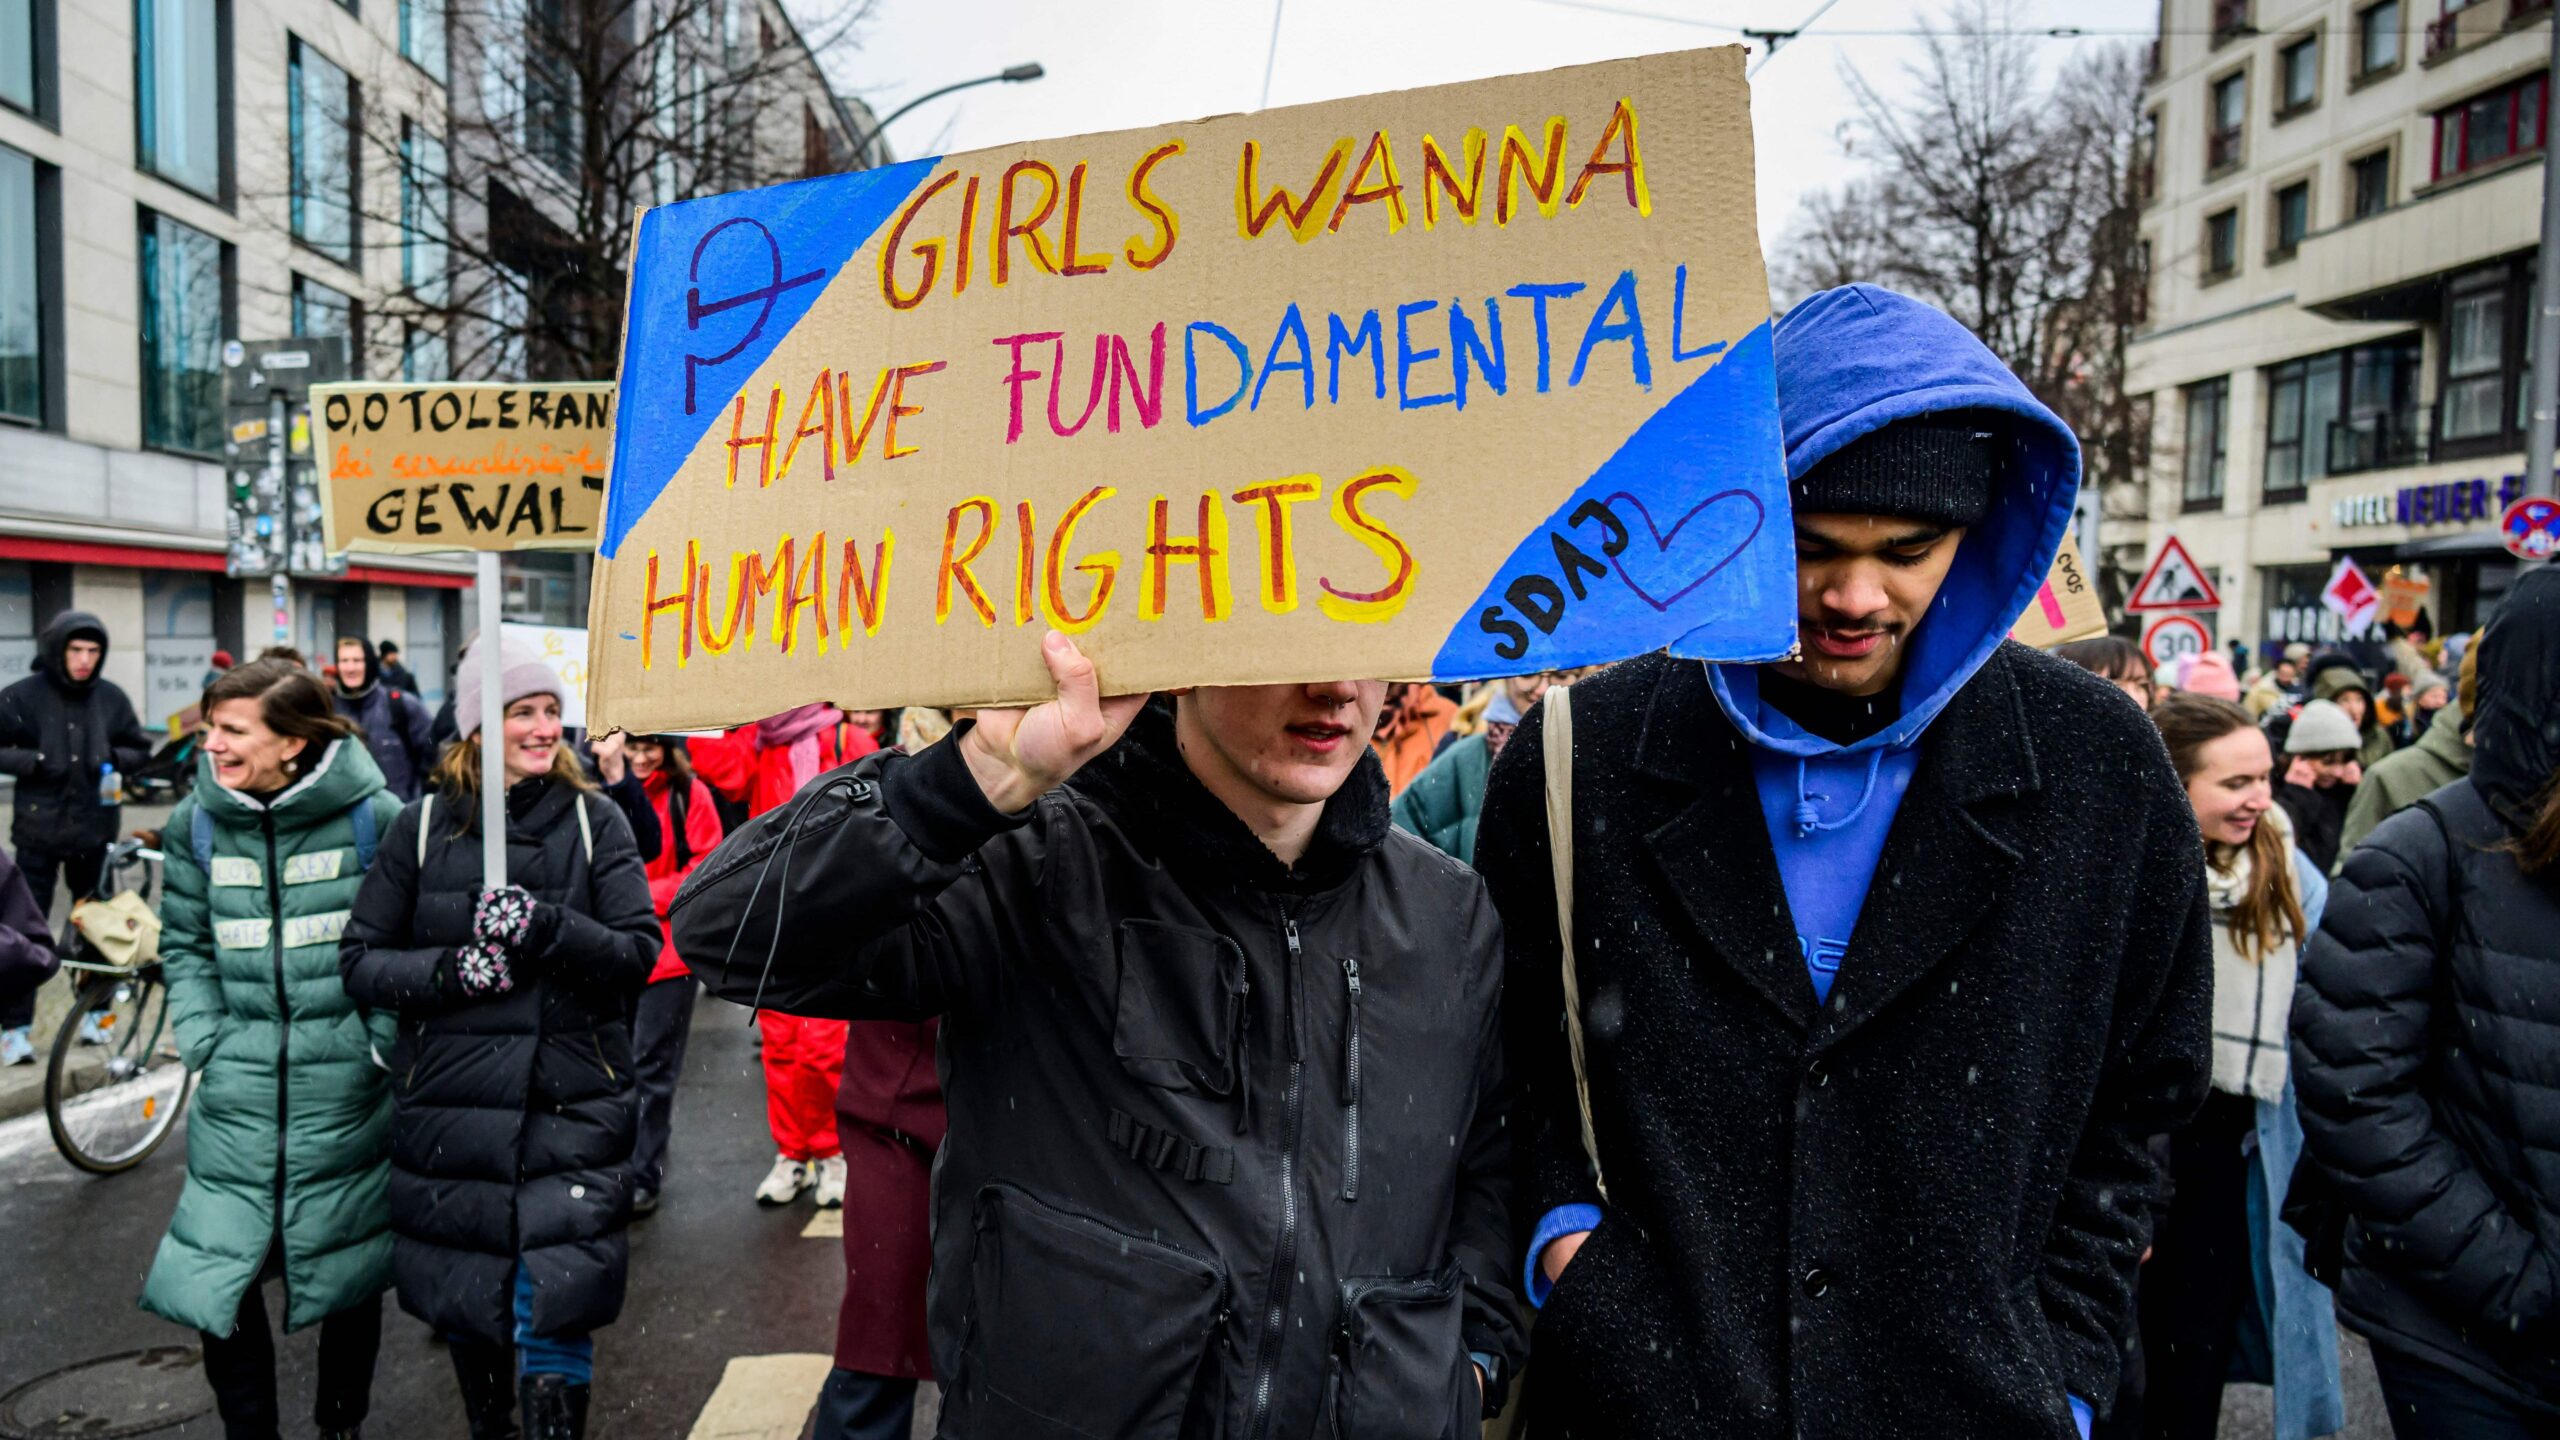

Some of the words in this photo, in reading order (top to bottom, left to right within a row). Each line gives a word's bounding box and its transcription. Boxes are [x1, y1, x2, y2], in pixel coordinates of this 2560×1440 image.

[877, 138, 1187, 312] GIRLS
[1234, 97, 1653, 245] WANNA
[400, 388, 616, 433] TOLERAN
[724, 360, 948, 490] HAVE
[992, 262, 1728, 445] FUNDAMENTAL
[642, 527, 896, 671] HUMAN
[936, 464, 1421, 636] RIGHTS
[1479, 498, 1630, 661] SDAJ
[2157, 632, 2198, 662] 30
[293, 852, 333, 881] SEX
